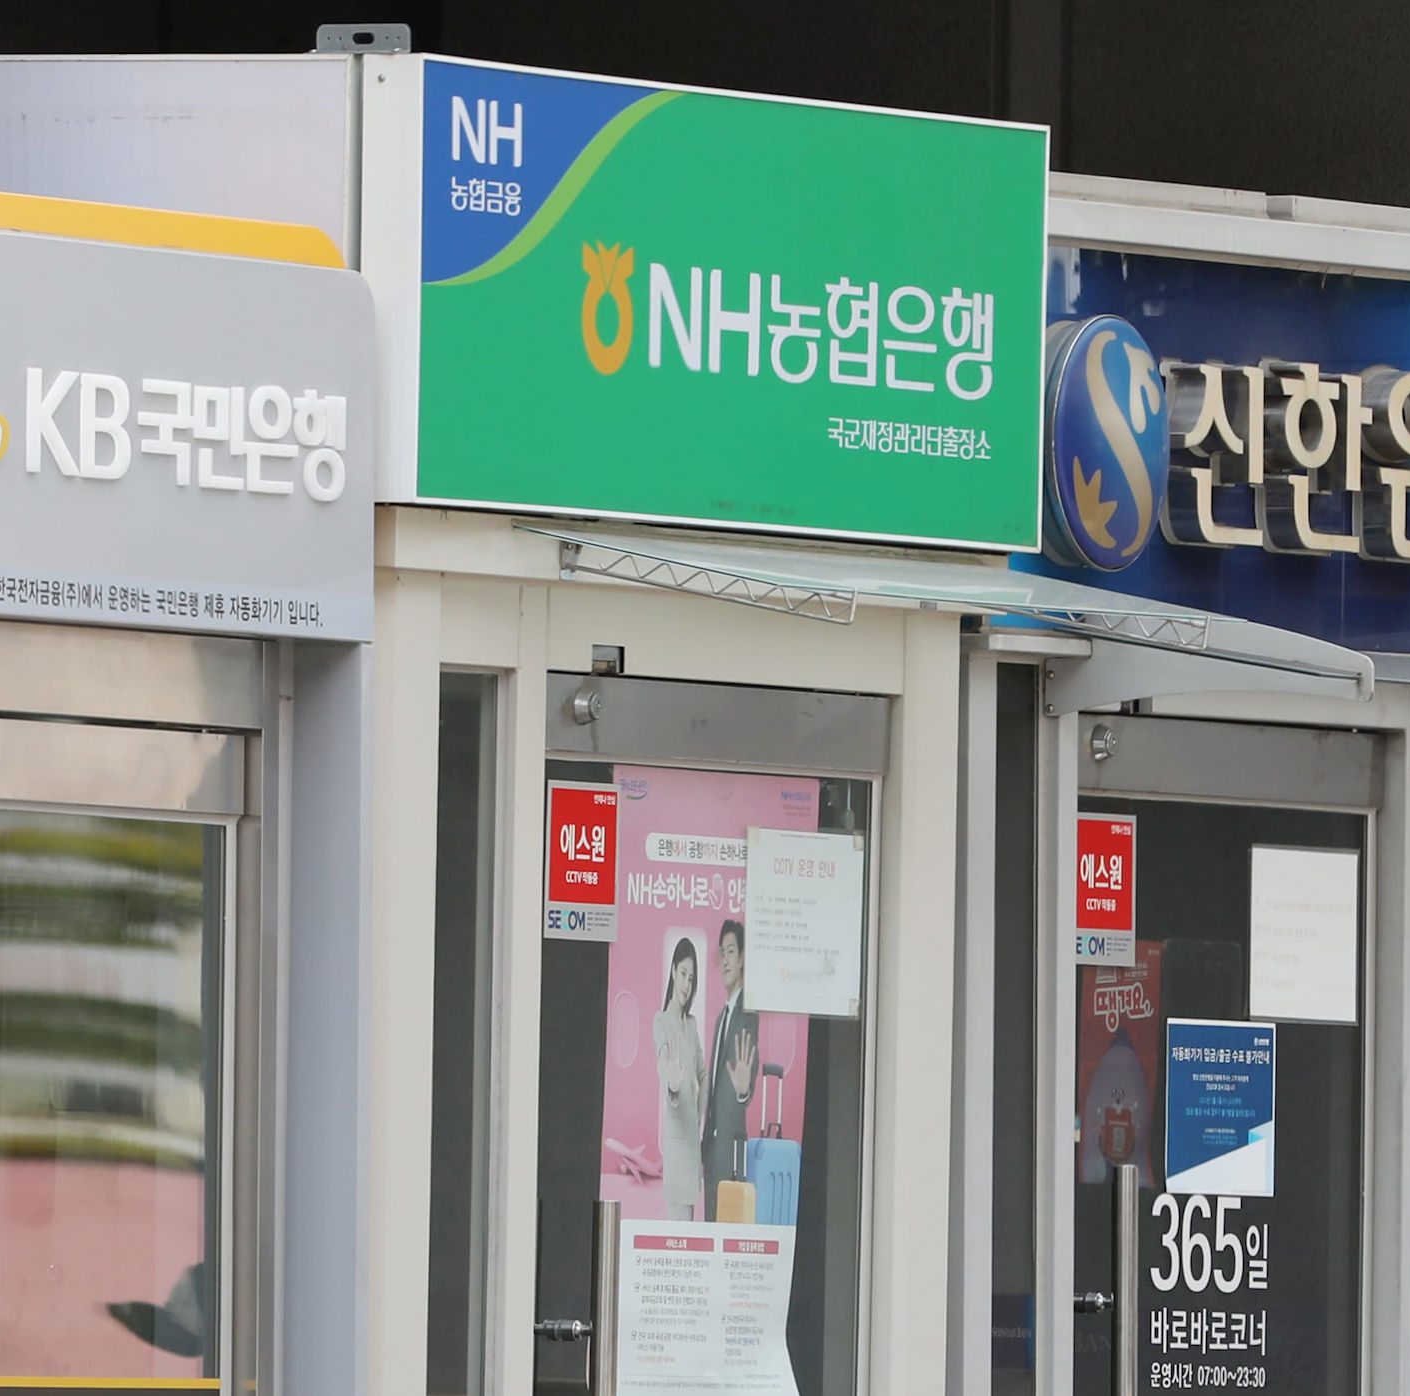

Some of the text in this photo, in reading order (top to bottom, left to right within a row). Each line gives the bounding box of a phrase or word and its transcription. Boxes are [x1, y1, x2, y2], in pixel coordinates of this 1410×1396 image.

[451, 95, 523, 168] NH
[451, 175, 522, 217] 농협금융
[648, 261, 995, 402] NH농협은행
[826, 416, 993, 461] 국군재정관리단출장소
[107, 587, 152, 615] 운영하는
[155, 589, 200, 619] 국민은행
[203, 592, 226, 620] 제휴
[229, 593, 284, 625] 자동화기기
[287, 598, 324, 628] 입니다.
[559, 823, 606, 863] 에스원
[773, 856, 795, 876] CCTV
[1079, 852, 1123, 891] 에스원
[626, 871, 711, 910] NH손하나로
[548, 909, 586, 932] SECOM
[1076, 935, 1105, 957] ECOM
[1171, 1046, 1203, 1062] 자동화기기
[1232, 1049, 1245, 1063] 수표
[1149, 1192, 1270, 1294] 365일
[1149, 1307, 1268, 1357] 바로바로코너
[1149, 1361, 1267, 1390] 운영시간 07:00~23:30
